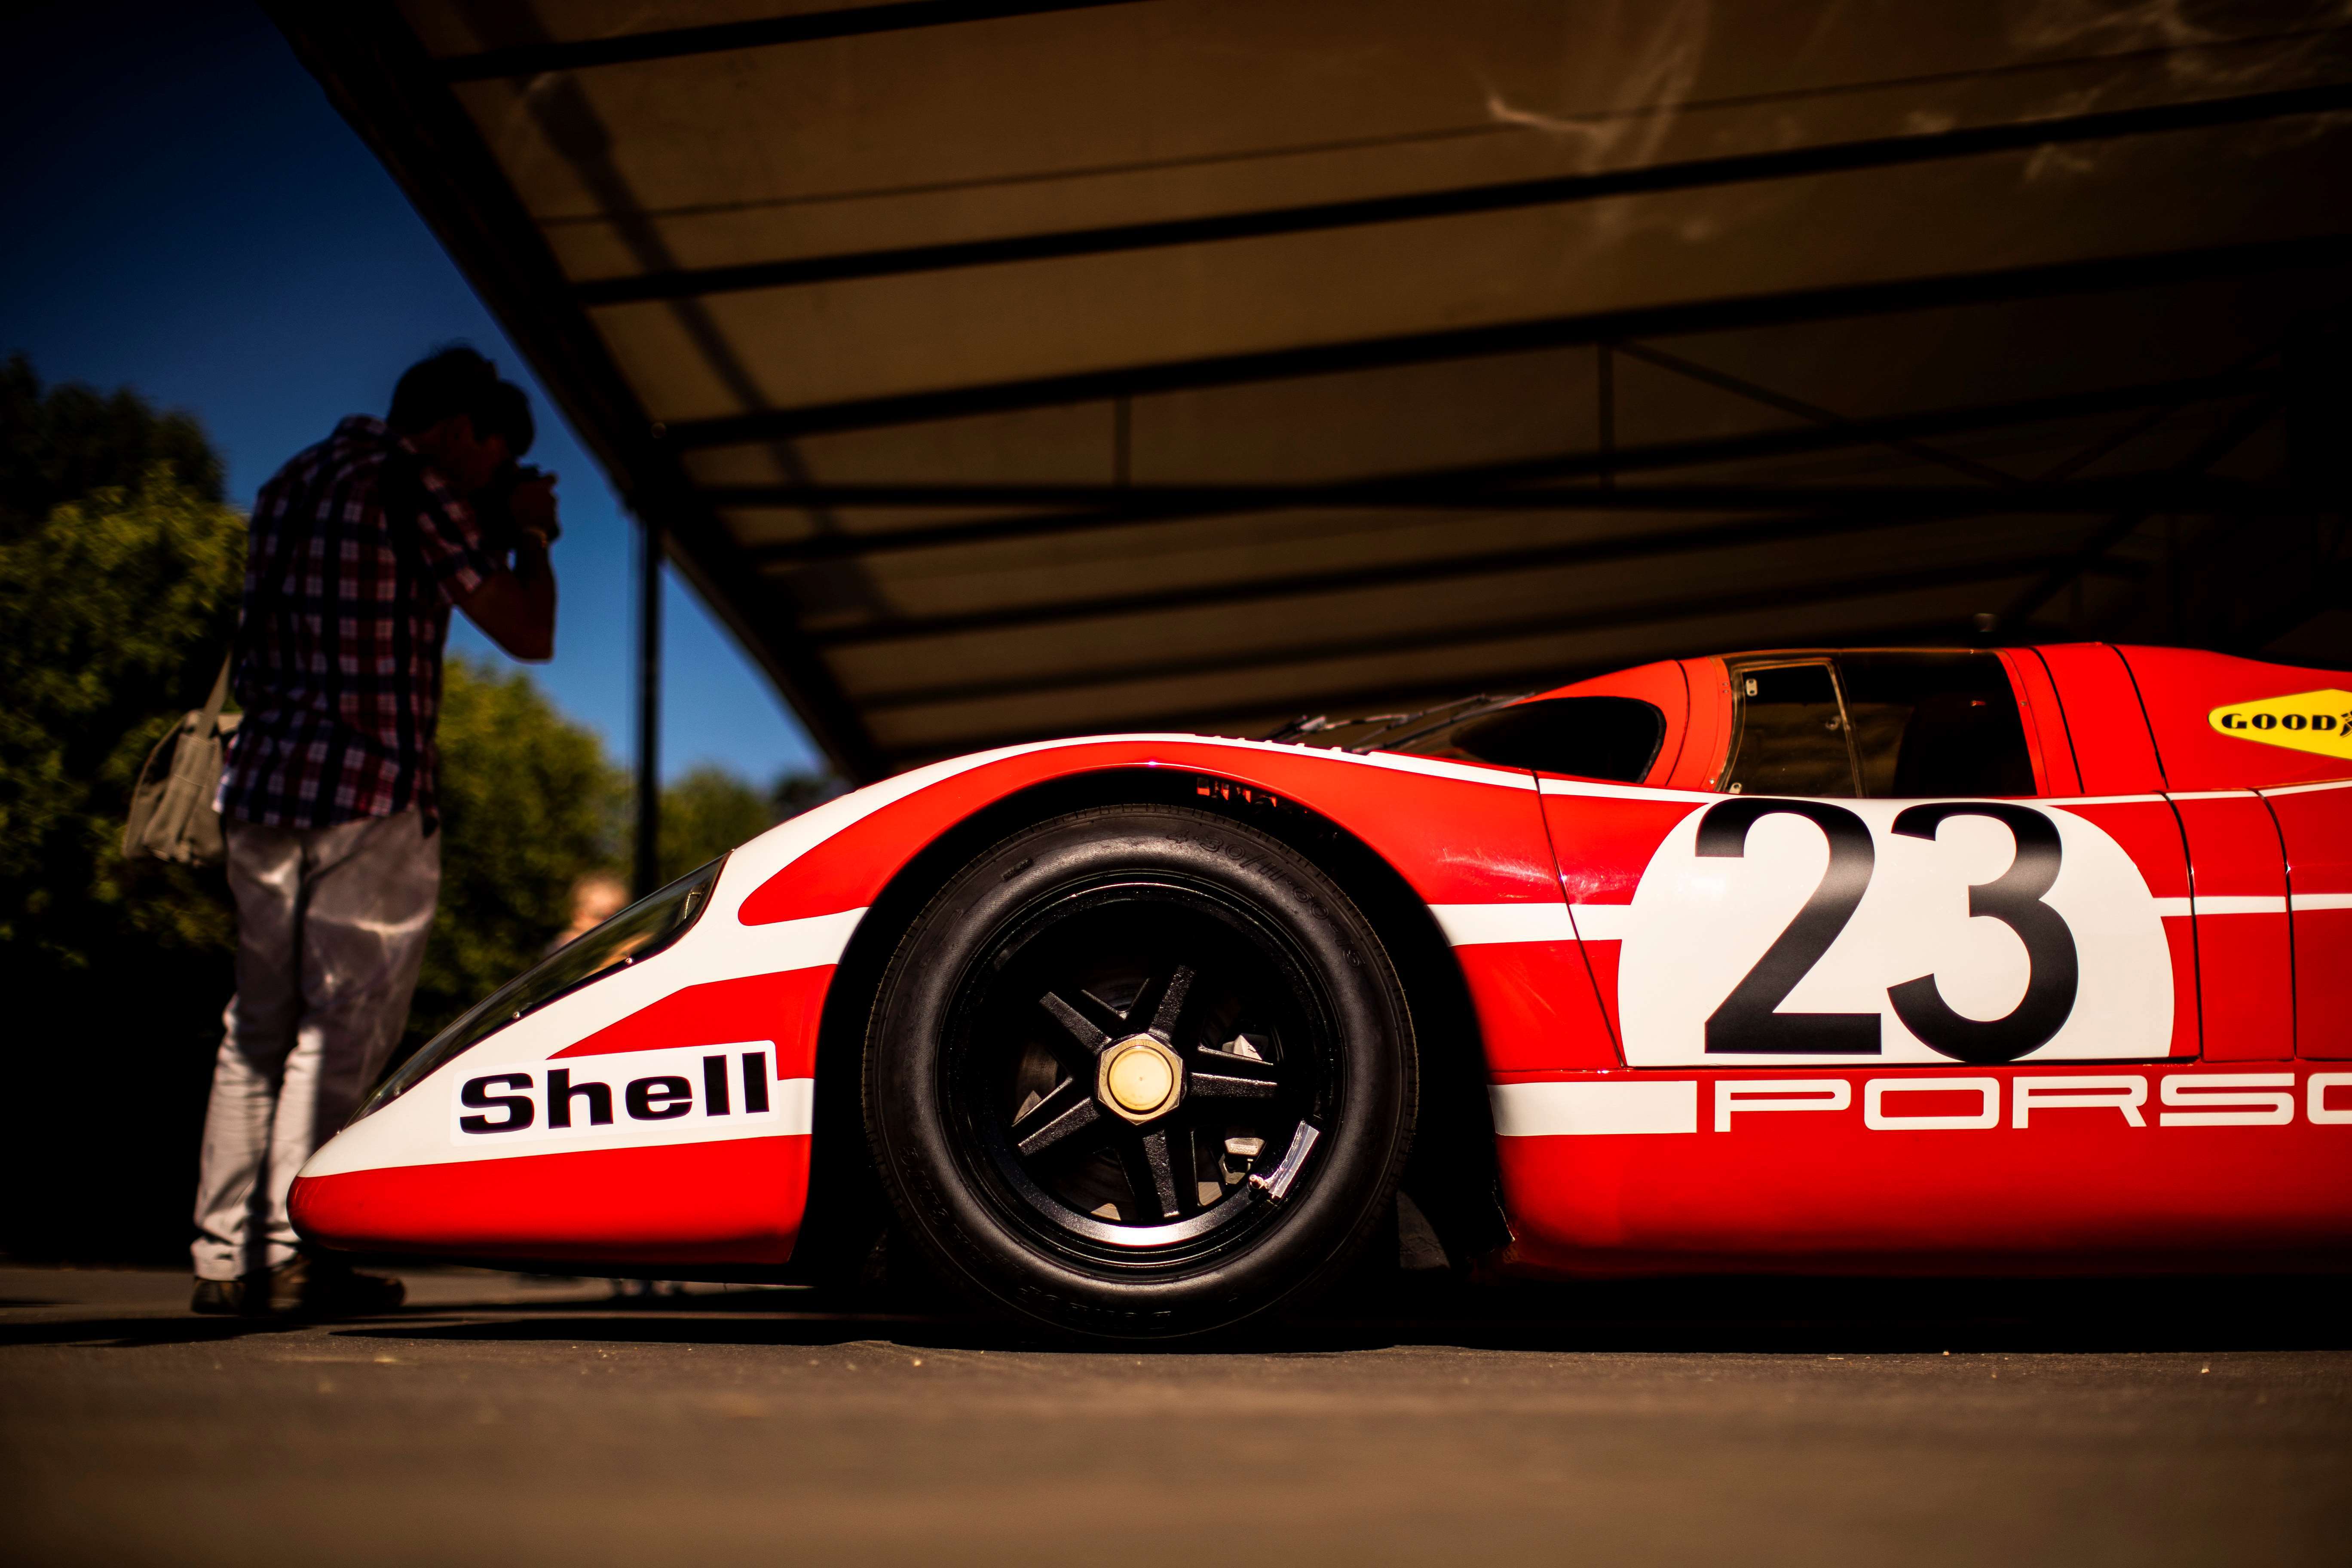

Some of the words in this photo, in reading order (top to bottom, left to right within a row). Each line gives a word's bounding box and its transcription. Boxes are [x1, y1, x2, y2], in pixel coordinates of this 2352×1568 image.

[2221, 713, 2337, 731] GOOD
[1695, 797, 2079, 1063] 23
[459, 1051, 770, 1135] Shell
